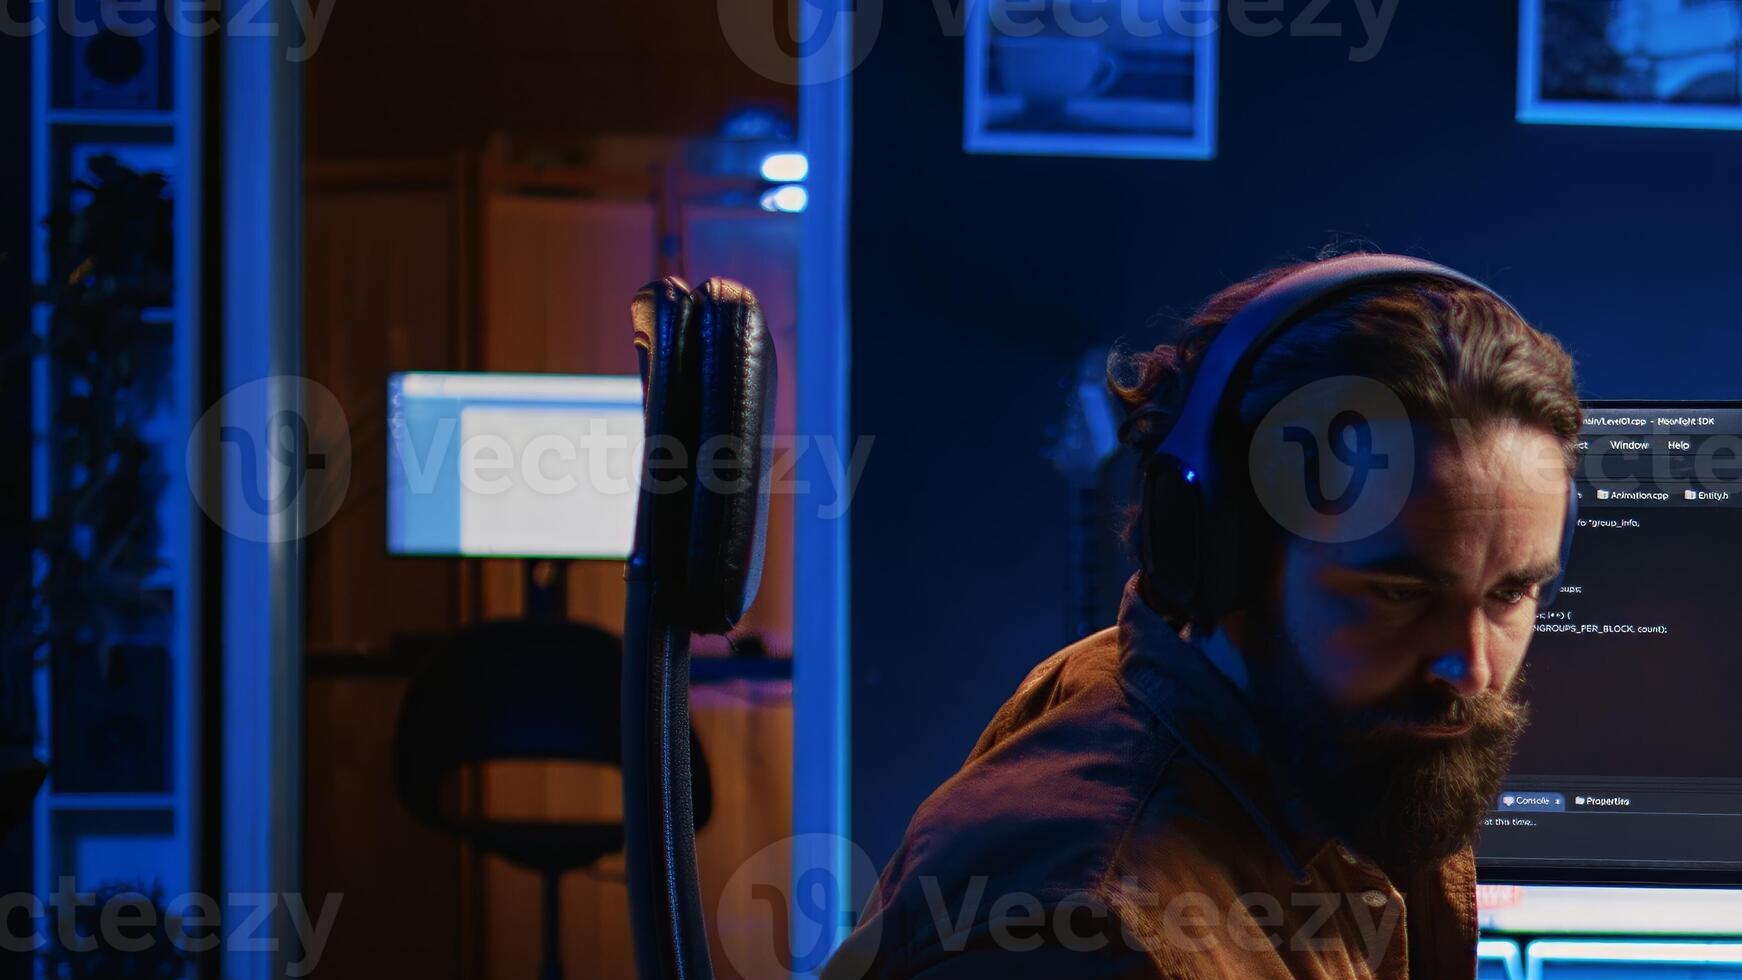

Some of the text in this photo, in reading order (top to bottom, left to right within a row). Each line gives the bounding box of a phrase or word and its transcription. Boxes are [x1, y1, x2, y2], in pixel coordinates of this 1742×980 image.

[1610, 440, 1649, 450] Window
[1667, 440, 1690, 451] Help
[1610, 491, 1669, 501] Animation.cpp
[1698, 491, 1729, 501] Entity.h
[1516, 796, 1550, 806] Console
